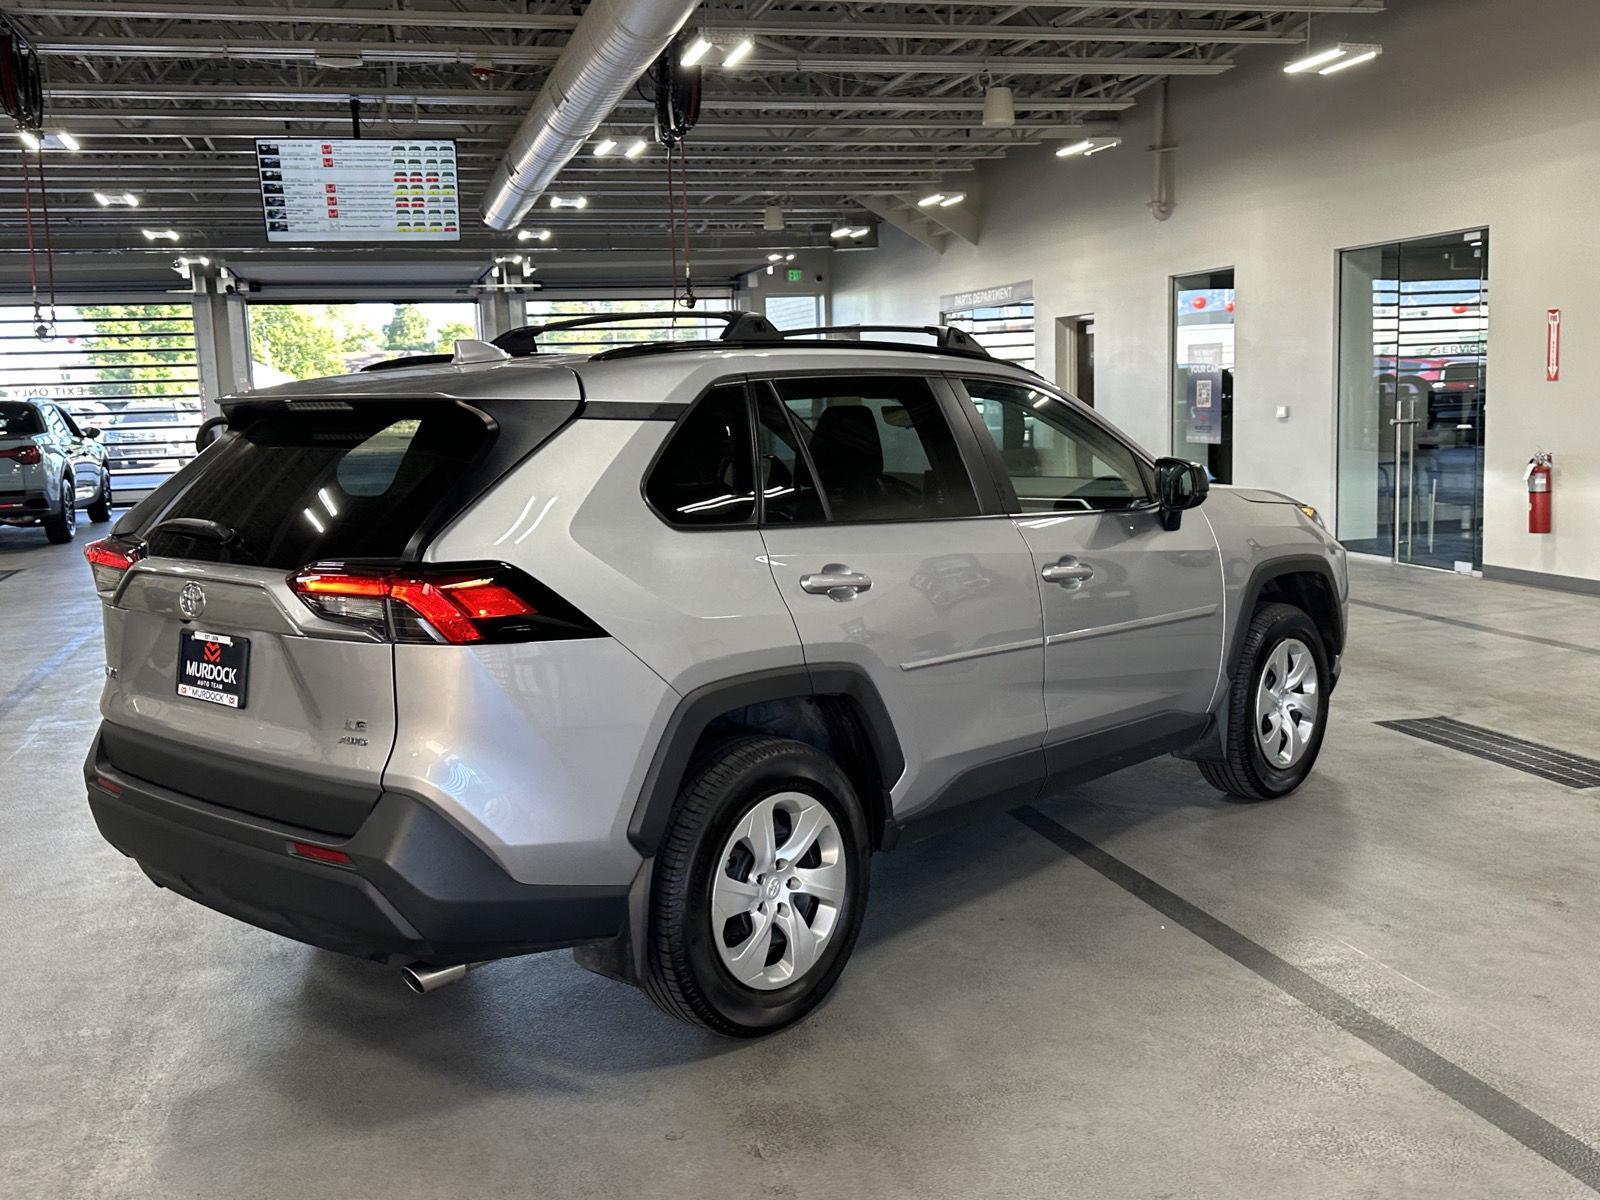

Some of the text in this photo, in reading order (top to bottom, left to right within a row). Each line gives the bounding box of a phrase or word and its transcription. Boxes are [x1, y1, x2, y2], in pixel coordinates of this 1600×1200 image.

[954, 287, 1013, 307] PARTS DEPARTMENT
[186, 660, 237, 684] MURDOCK
[211, 682, 223, 690] TEAM
[191, 689, 225, 702] MURDOCK
